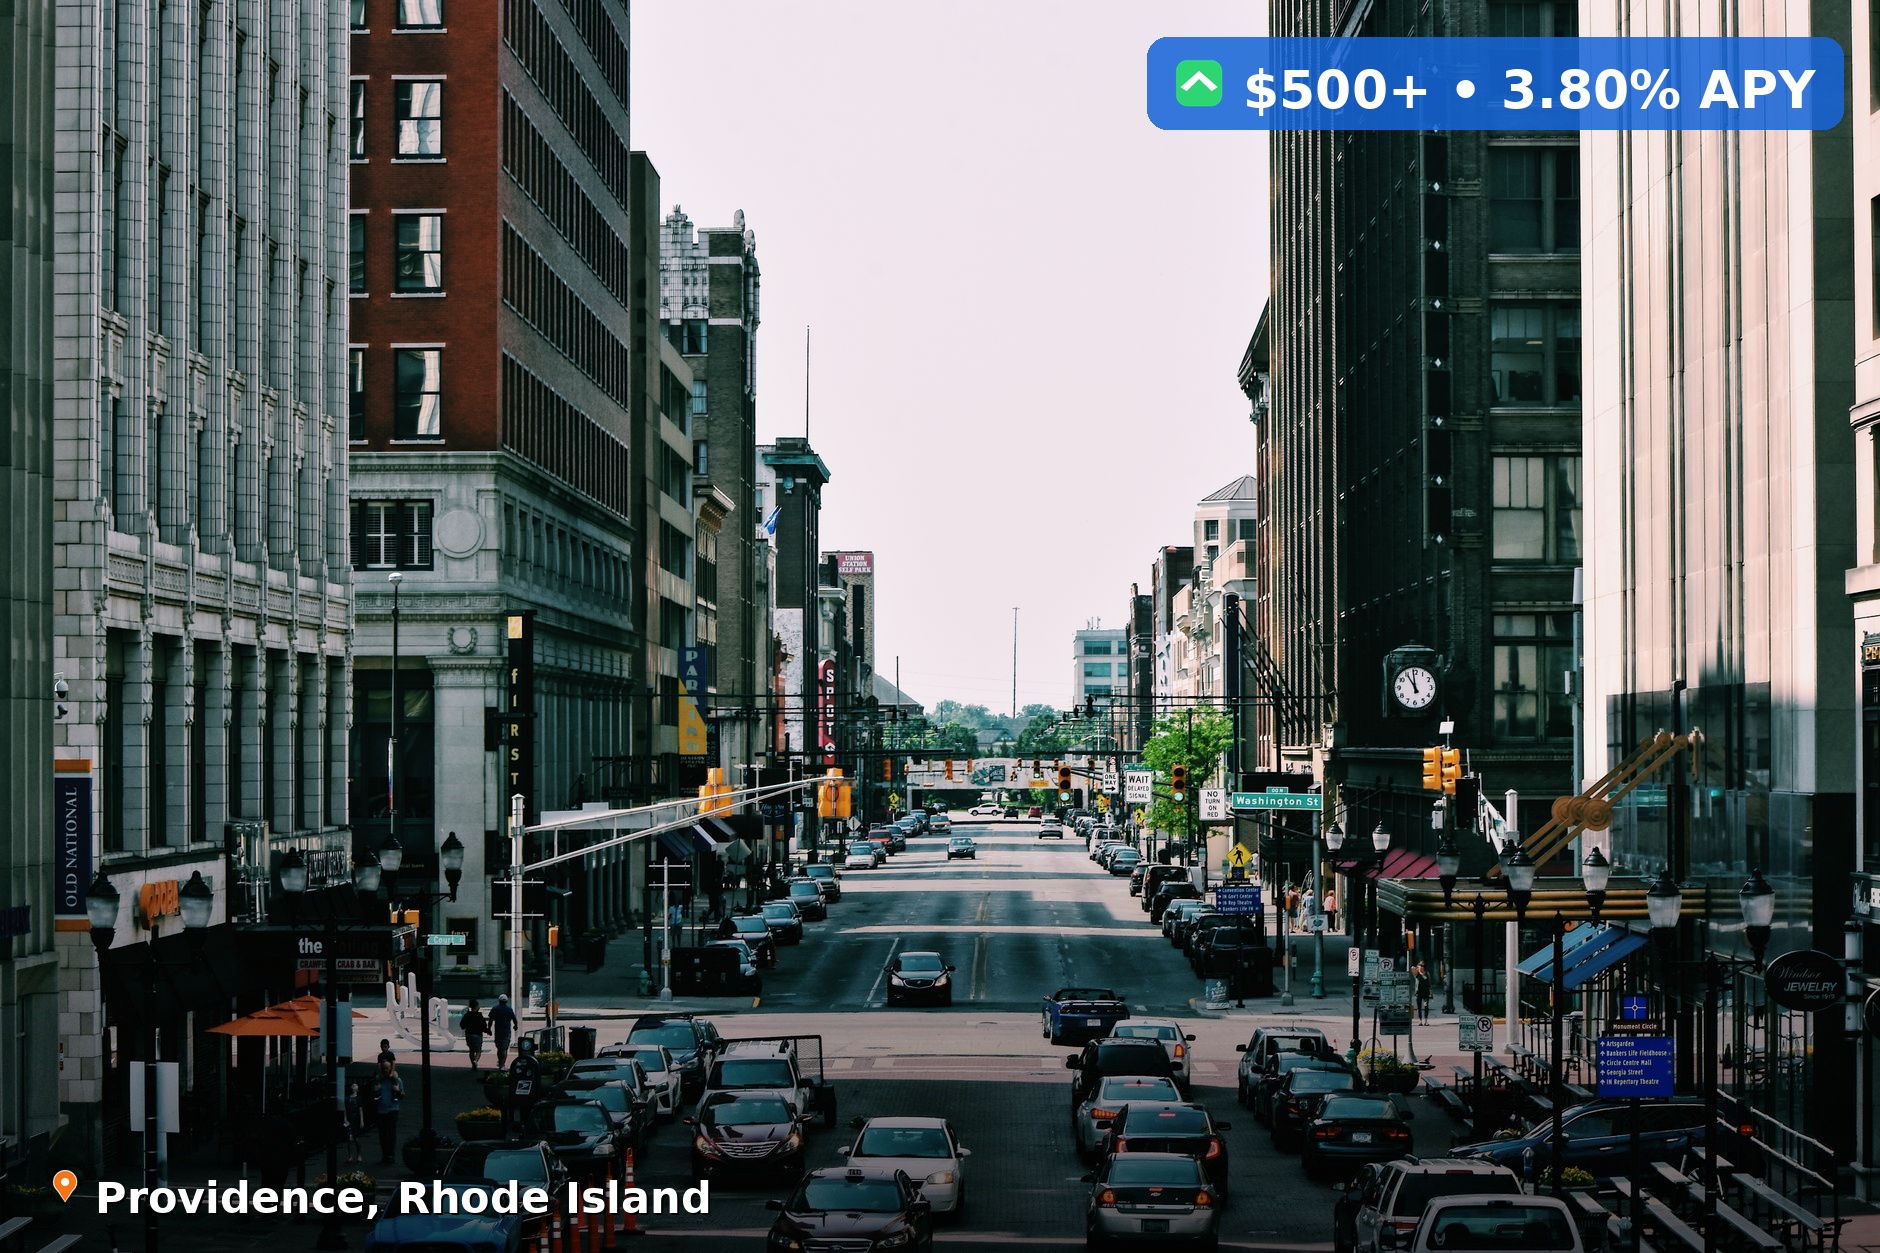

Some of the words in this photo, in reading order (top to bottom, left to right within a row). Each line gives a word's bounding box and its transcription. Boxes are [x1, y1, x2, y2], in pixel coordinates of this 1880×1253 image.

[1236, 796, 1302, 808] Washington
[1307, 798, 1319, 806] St
[65, 786, 78, 869] NATIONAL
[65, 873, 78, 907] OLD
[298, 937, 323, 954] the
[434, 935, 455, 945] Court
[300, 960, 328, 968] CRAWFIS
[337, 960, 355, 968] CRAB
[1773, 963, 1825, 979] Windsor
[1784, 982, 1838, 992] JEWELRY
